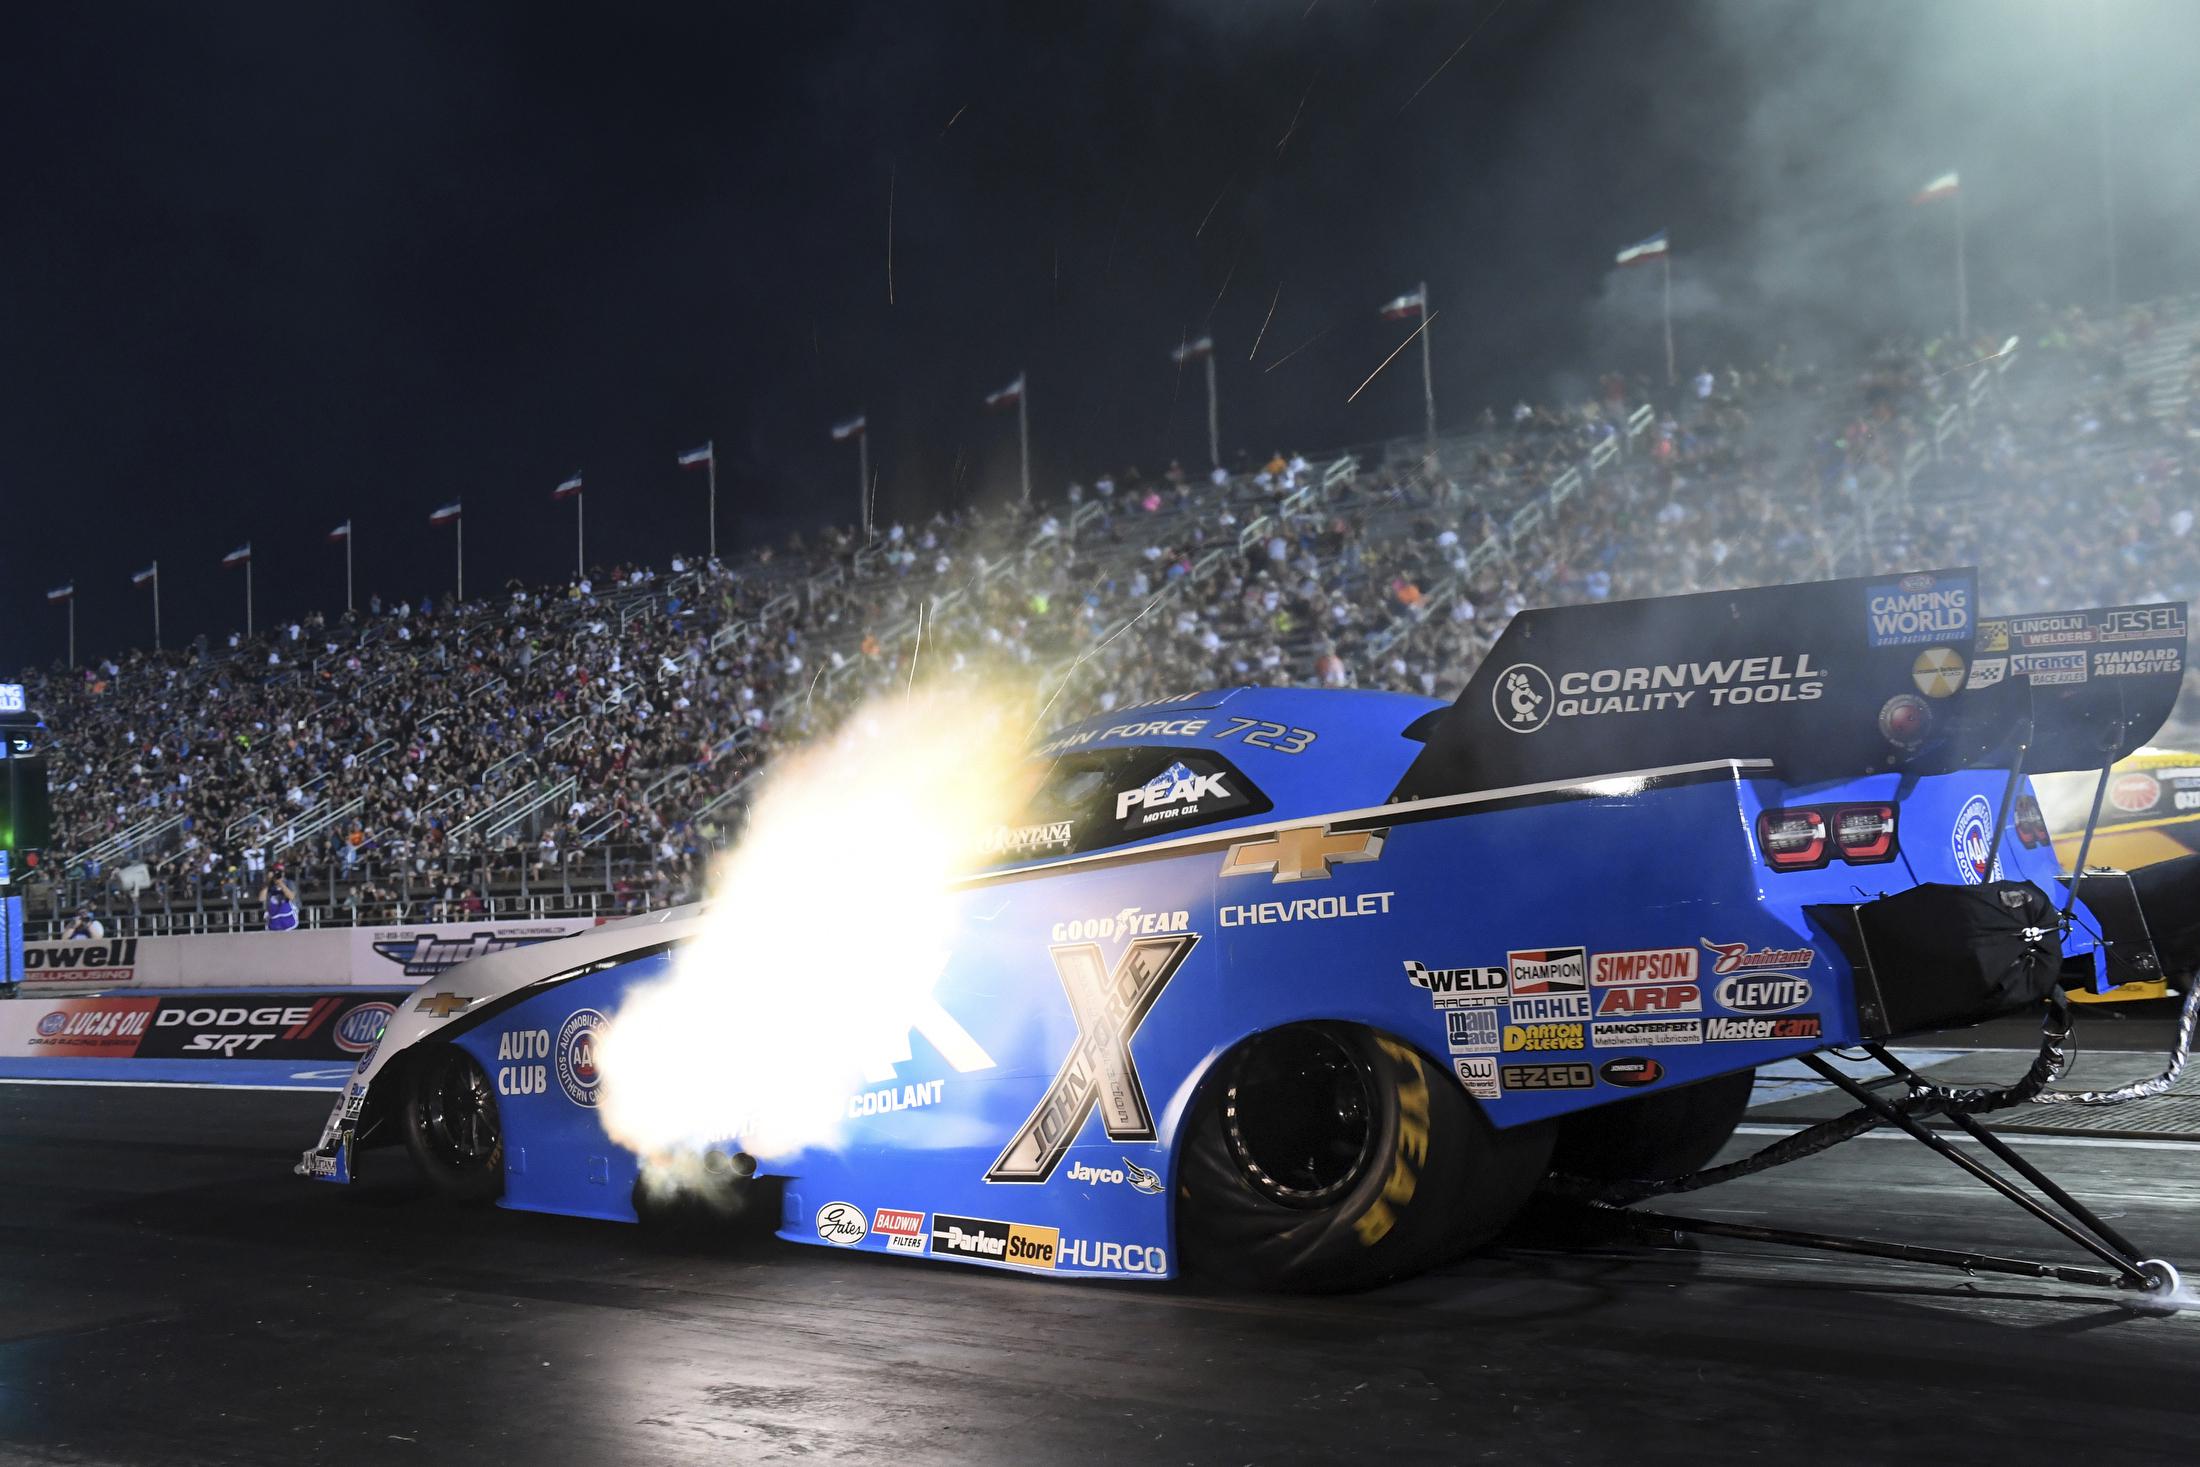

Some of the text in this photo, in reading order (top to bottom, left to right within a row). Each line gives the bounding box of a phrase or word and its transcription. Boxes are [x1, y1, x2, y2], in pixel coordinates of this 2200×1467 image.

[1871, 589, 1966, 615] CAMPING
[1871, 608, 1967, 636] WORLD
[2012, 617, 2083, 634] LINCOLN
[2101, 609, 2183, 633] JESEL
[2029, 631, 2092, 644] WELDERS
[2012, 653, 2085, 671] Strange
[2094, 648, 2178, 664] STANDARD
[2094, 659, 2181, 676] ABRASIVES
[1559, 654, 1819, 695] CORNWELL
[2032, 672, 2086, 684] RACE AXLES
[1556, 681, 1824, 717] QUALITY TOOLS
[1100, 719, 1210, 741] FORCE
[1213, 716, 1318, 754] 723
[1115, 772, 1232, 820] PEAK
[1142, 805, 1199, 824] MOTOR OIL
[1219, 891, 1395, 928] CHEVROLET
[24, 939, 138, 969] owell
[1514, 963, 1581, 980] CHAMPION
[1596, 952, 1690, 982] SIMPSON
[1428, 967, 1508, 993] WELD
[1719, 978, 1808, 1007] CLEVITE
[1434, 996, 1509, 1009] RACING
[1513, 997, 1590, 1020] MAHLE
[1600, 986, 1699, 1012] ARP
[63, 1011, 124, 1036] LUCAS
[117, 1011, 150, 1036] OIL
[155, 1007, 313, 1027] DODGE
[1448, 1011, 1497, 1032] main
[1705, 1018, 1819, 1039] Mastercam
[560, 1014, 599, 1050] AUTOMOBILE
[1503, 1023, 1584, 1051] DARTON
[1525, 1037, 1584, 1051] SLEEVES
[1595, 1033, 1700, 1045] Metalworking Lubricants
[182, 1034, 277, 1057] SRT
[498, 1029, 550, 1061] AUTO
[573, 1044, 600, 1068] AA
[1032, 1062, 1087, 1163] JOHN
[1084, 950, 1151, 1072] FORCE
[498, 1065, 547, 1096] CLUB
[559, 1056, 588, 1103] SOUTHERN
[849, 1080, 945, 1118] COOLANT
[1067, 1161, 1124, 1184] Jayco
[820, 1208, 866, 1243] Gates
[876, 1213, 920, 1232] BALDWIN
[893, 1236, 923, 1249] FILTERS
[947, 1226, 1053, 1262] Parker Store
[1058, 1238, 1168, 1274] HURCO
